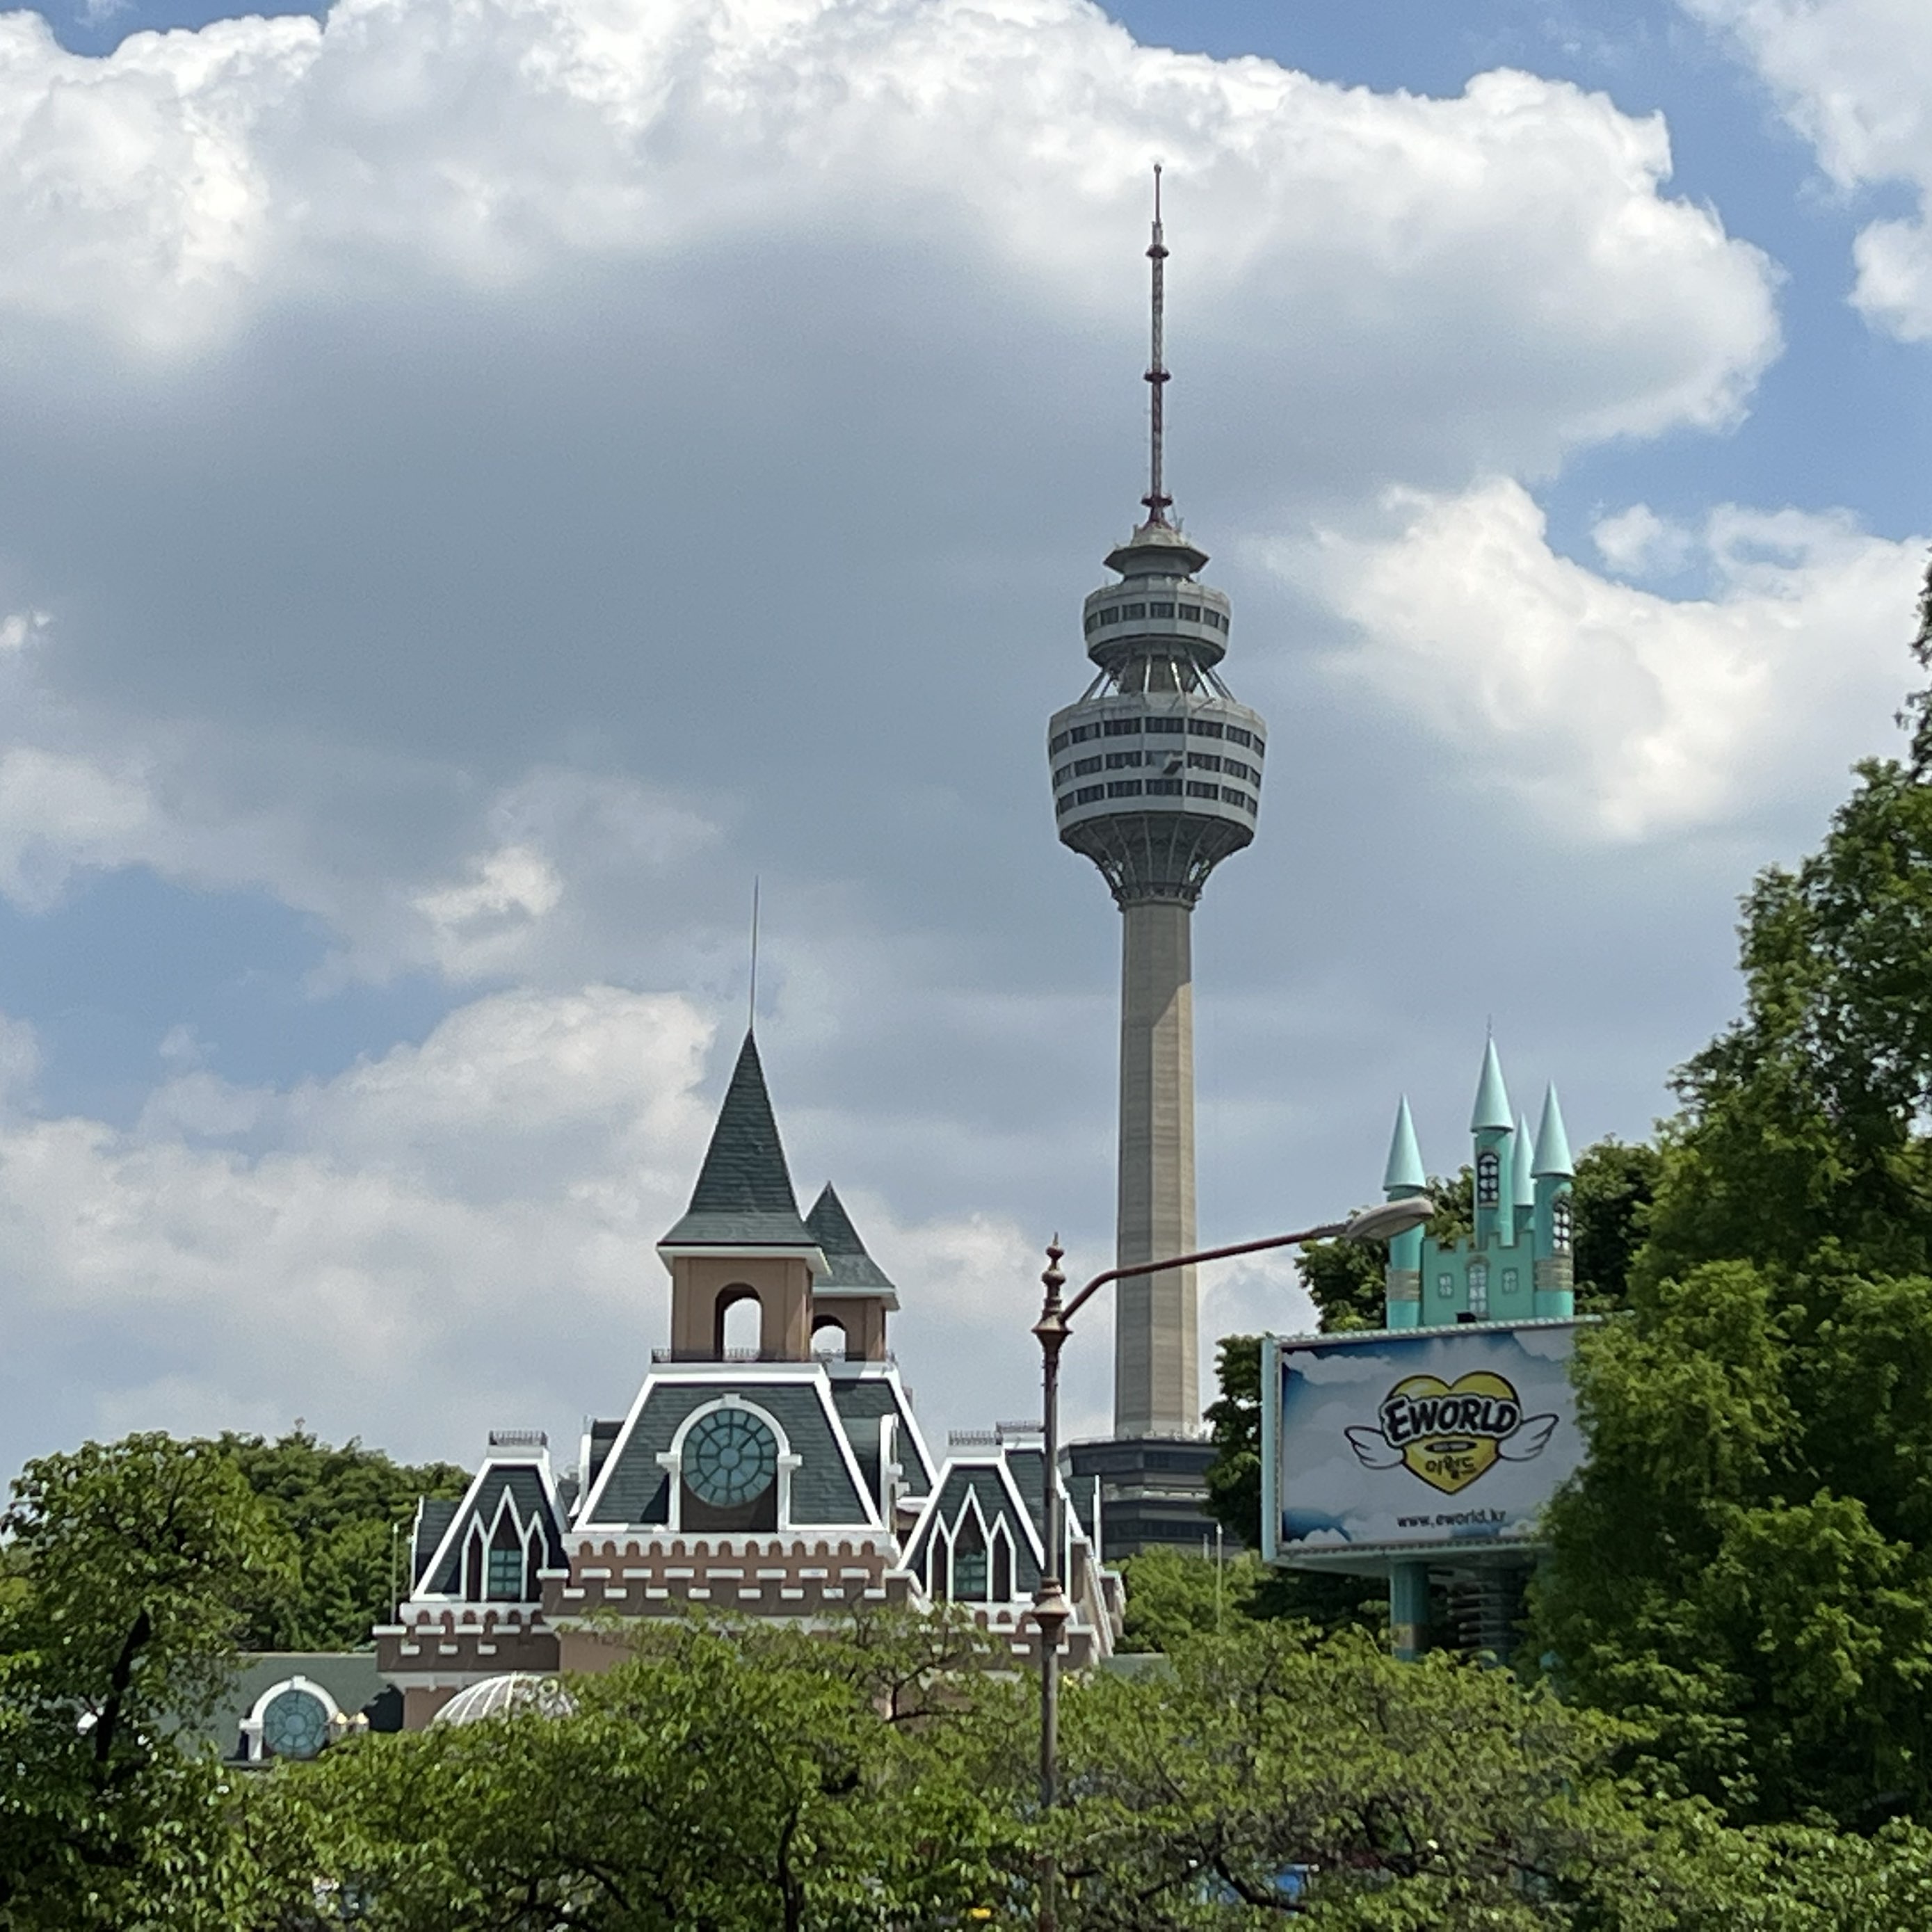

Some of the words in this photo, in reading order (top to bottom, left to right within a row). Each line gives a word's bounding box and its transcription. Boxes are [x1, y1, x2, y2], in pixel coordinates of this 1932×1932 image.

[1385, 1398, 1518, 1442] EWORLD
[1425, 1454, 1476, 1480] 이월드
[1396, 1508, 1506, 1528] www.eworld.kr
